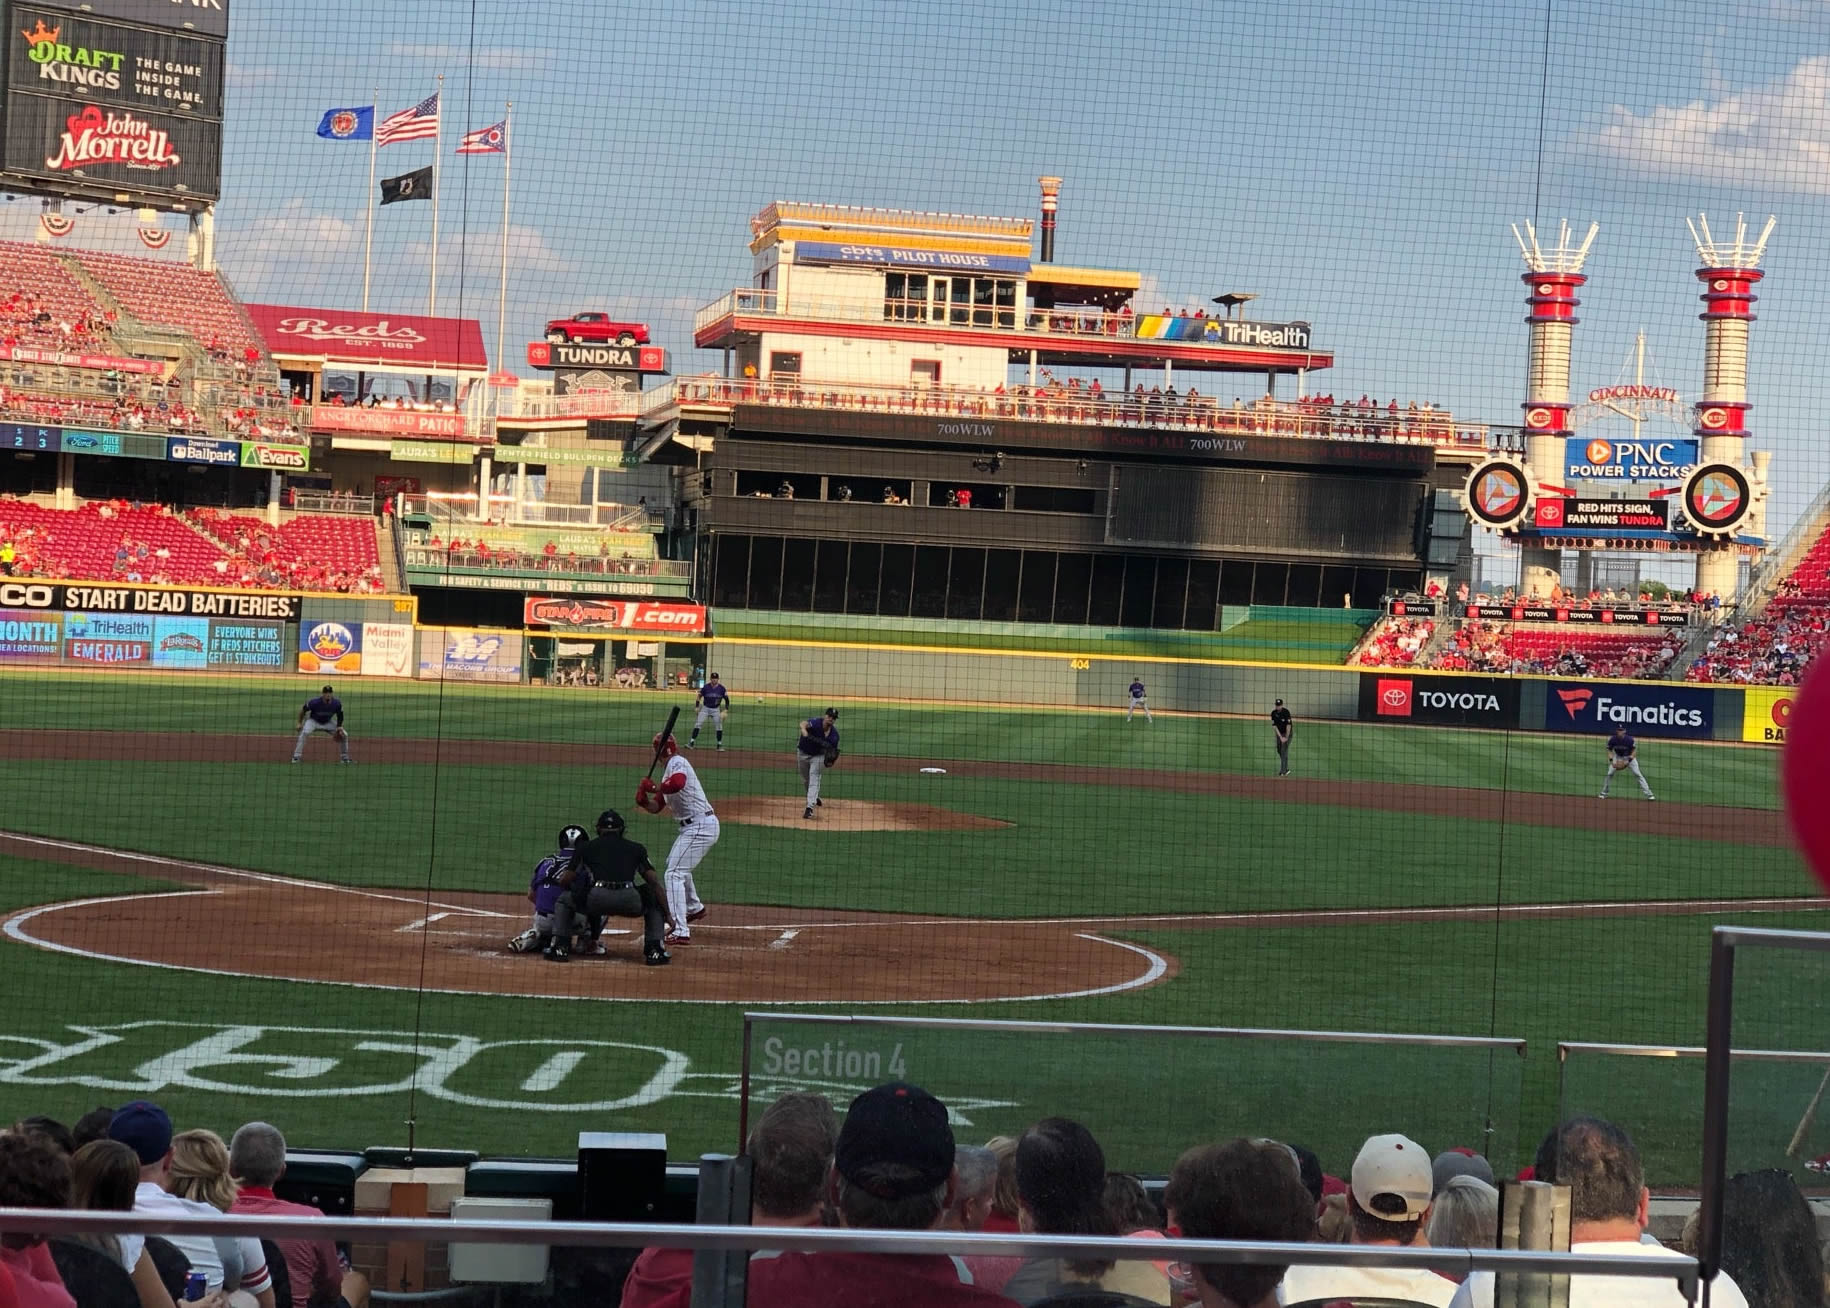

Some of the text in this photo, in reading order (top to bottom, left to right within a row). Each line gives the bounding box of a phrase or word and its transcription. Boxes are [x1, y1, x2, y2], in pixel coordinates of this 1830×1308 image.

[28, 40, 125, 71] DRAFT
[39, 60, 121, 90] KINGS
[135, 57, 202, 77] THE GAME
[135, 70, 180, 86] INSIDE
[135, 84, 204, 104] THE GAME.
[97, 112, 148, 137] John
[46, 128, 181, 169] Morrell
[840, 245, 990, 267] cbts PILOT HOUSE
[276, 317, 427, 342] Reds
[1224, 322, 1308, 348] TriHealth
[345, 339, 376, 348] EST.
[557, 347, 633, 366] TUNDRA
[1589, 385, 1678, 403] CINCINNATI
[318, 410, 357, 423] ANGRY
[359, 411, 416, 426] ORCHARD
[937, 423, 996, 437] 700WLW
[15, 436, 47, 448] 2 3
[1189, 438, 1247, 452] 700WLW
[187, 446, 237, 463] Ballpark
[260, 448, 304, 467] Evans
[393, 445, 437, 459] LAURA'S
[535, 450, 561, 460] FIELD
[563, 453, 604, 463] BULLPEN
[1613, 442, 1675, 466] PNC
[1570, 465, 1690, 479] POWER STACKS
[1577, 503, 1654, 516] RED HITS SIGN,
[1567, 514, 1664, 526] FAN WINS TUNDRA
[455, 577, 482, 587] SAFETY
[523, 580, 541, 590] TEXT
[65, 587, 130, 610] START
[133, 590, 186, 613] DEAD
[536, 605, 571, 619] STAR
[583, 607, 614, 621] FIRE
[1525, 610, 1549, 618] TOYOTA
[1615, 613, 1639, 621] TOYOTA
[92, 619, 150, 636] TriHealth
[215, 626, 278, 640] EVERYONE WINS
[367, 626, 405, 638] Miami
[72, 642, 142, 664] EMERALD
[211, 639, 281, 653] IF REDS PITCHERS
[208, 652, 223, 664] GET
[234, 653, 281, 666] STRIKEOUTS
[1419, 691, 1500, 711] TOYOTA
[1596, 697, 1703, 727] Fanatics
[764, 1036, 907, 1081] Section 4
